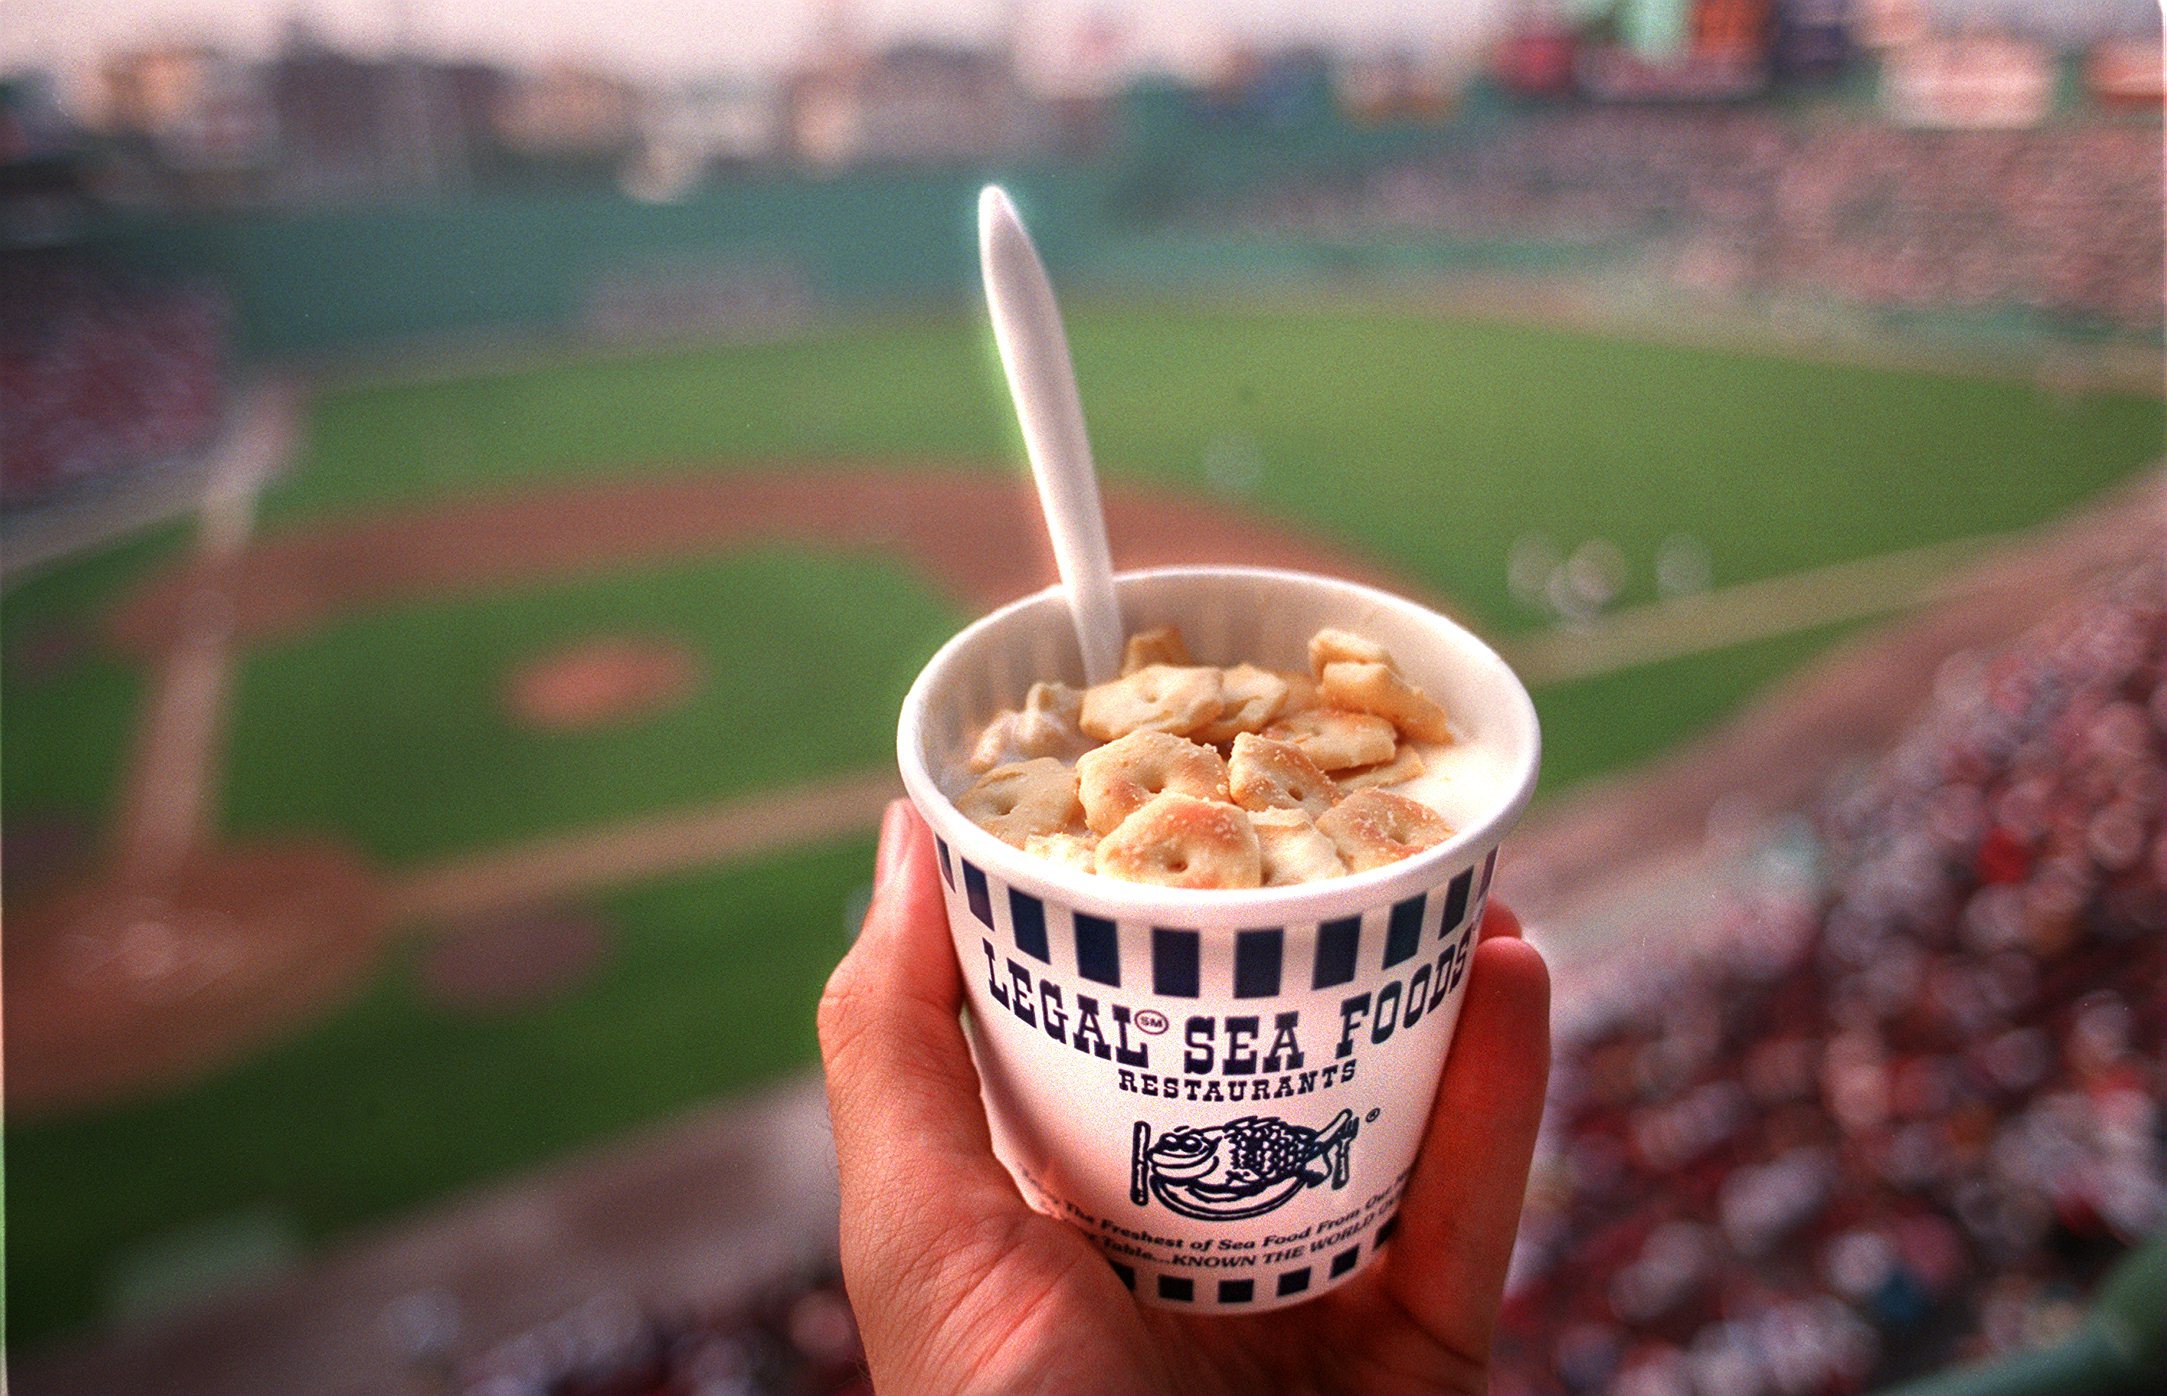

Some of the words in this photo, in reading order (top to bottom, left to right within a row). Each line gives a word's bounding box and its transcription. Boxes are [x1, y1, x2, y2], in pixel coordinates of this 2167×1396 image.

[982, 937, 1149, 1068] LEGAL
[1184, 1011, 1304, 1076] SEA
[1335, 922, 1472, 1060] FOODS
[1118, 1059, 1357, 1101] RESTAURANTS
[1064, 1200, 1095, 1224] The
[1101, 1219, 1183, 1249] Freshest
[1190, 1239, 1213, 1251] of
[1217, 1239, 1255, 1250] Sea
[1263, 1226, 1312, 1248] Food
[1316, 1209, 1360, 1234] From
[1264, 1245, 1305, 1264] THE
[1311, 1213, 1375, 1252] WORLD
